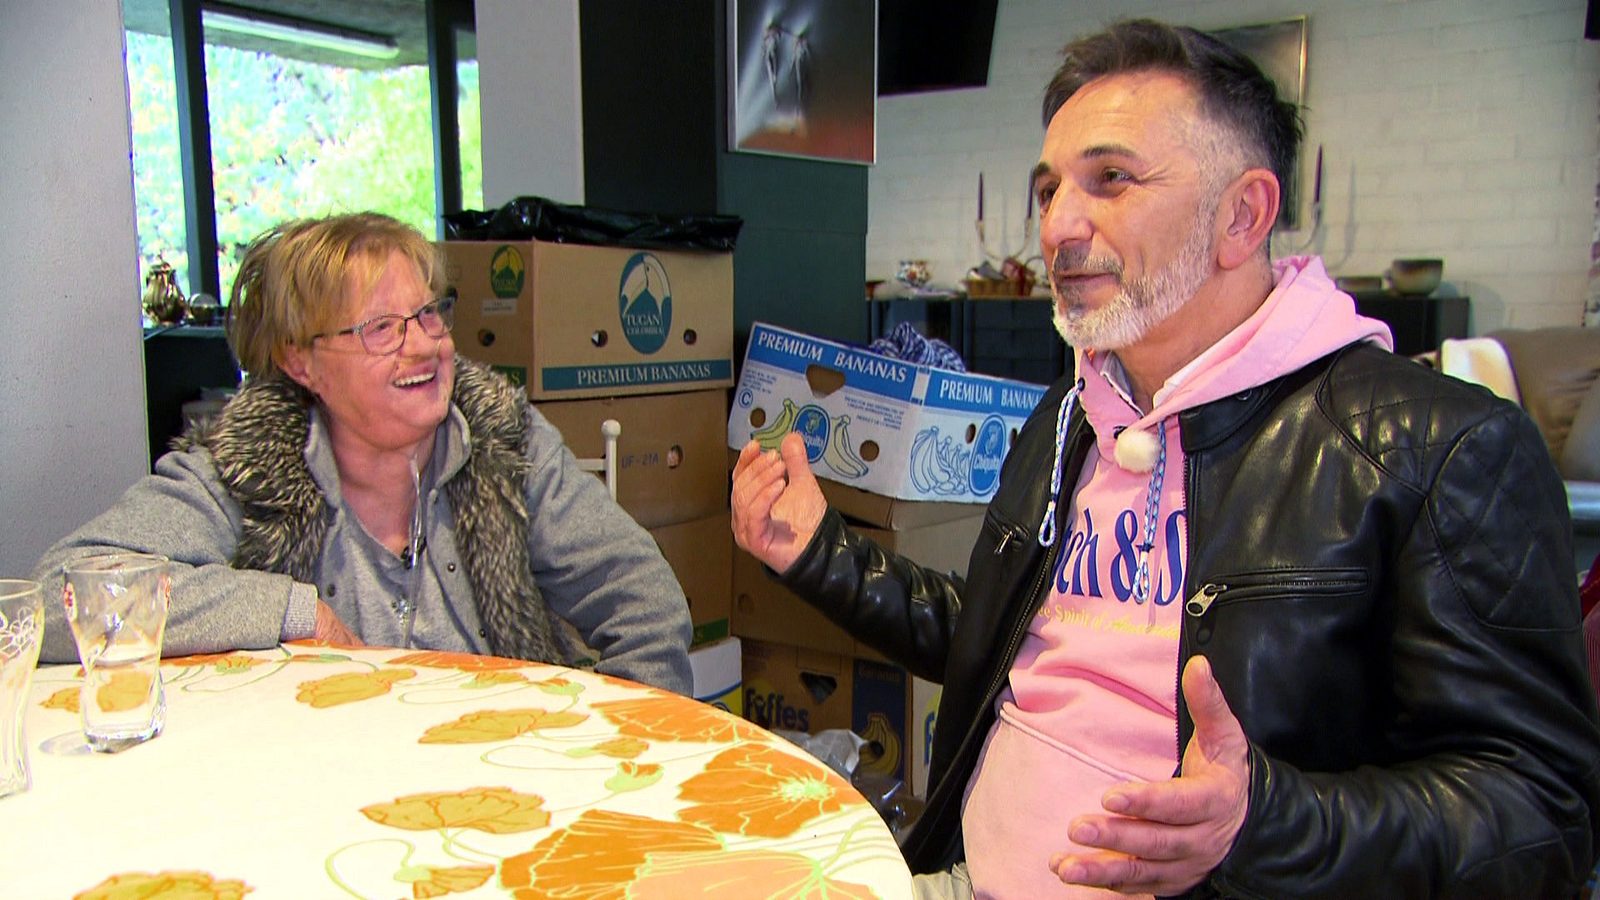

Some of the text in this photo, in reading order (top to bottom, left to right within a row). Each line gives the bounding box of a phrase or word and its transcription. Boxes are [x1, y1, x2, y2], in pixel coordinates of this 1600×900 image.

[626, 313, 660, 327] TUCAN
[757, 331, 907, 383] PREMIUM BANANAS
[577, 363, 711, 385] PREMIUM BANANAS
[940, 379, 1044, 410] PREMIUM BANANA
[1110, 510, 1154, 605] &
[1154, 509, 1187, 606] S
